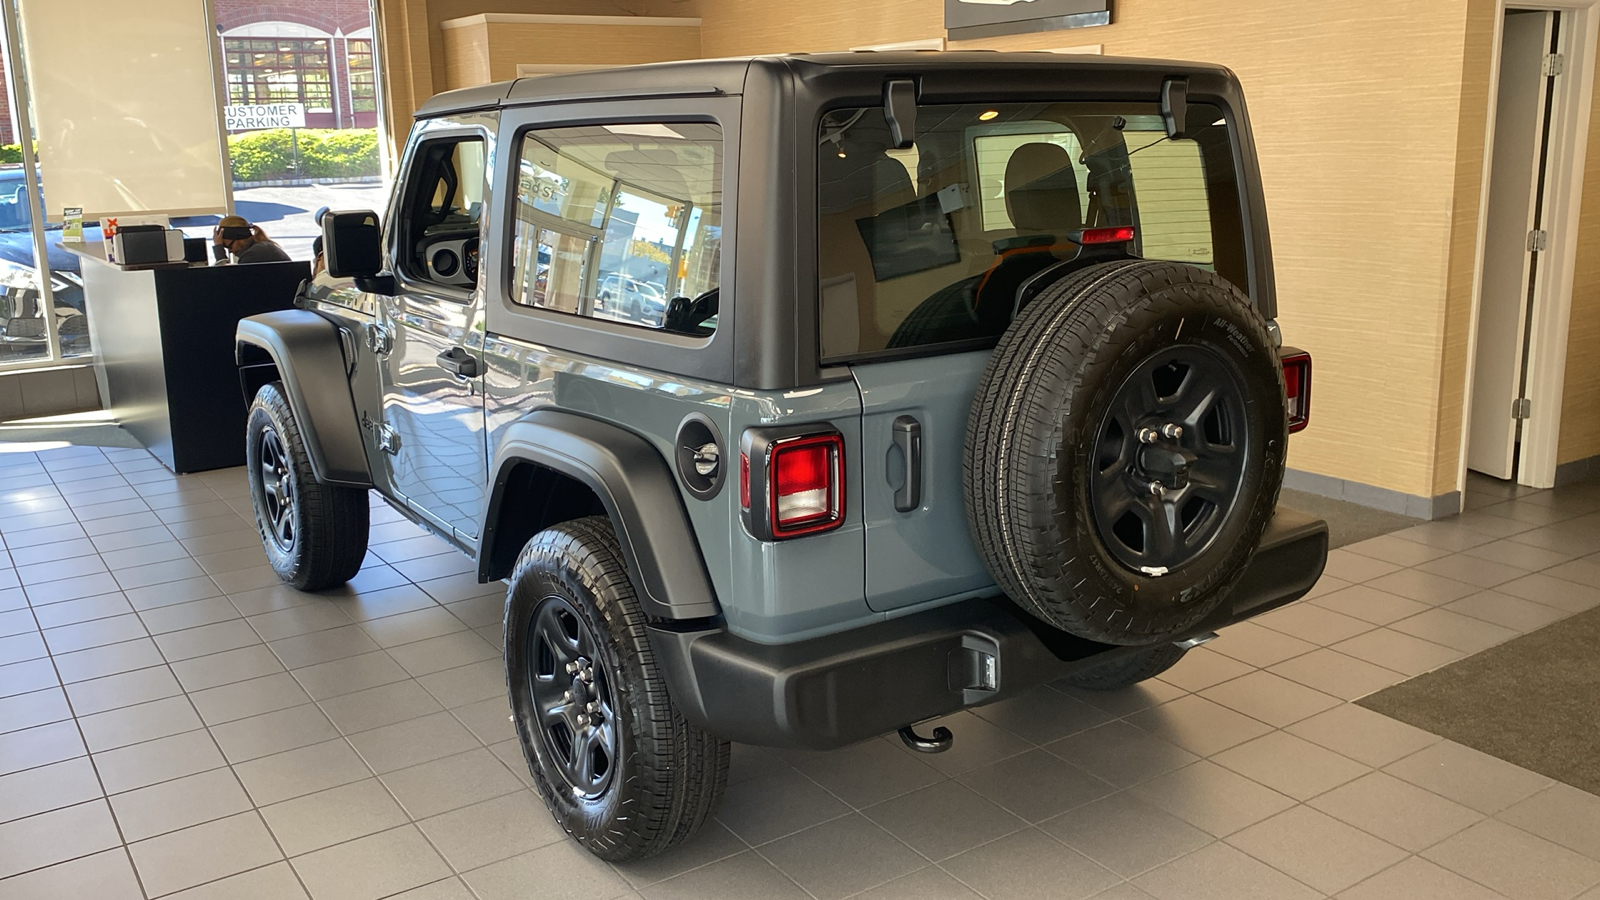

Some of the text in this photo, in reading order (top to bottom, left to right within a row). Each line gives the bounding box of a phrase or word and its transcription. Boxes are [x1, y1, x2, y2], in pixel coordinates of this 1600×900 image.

[224, 105, 297, 119] USTOMER
[227, 116, 290, 129] PARKING
[541, 186, 558, 201] St.
[1213, 317, 1255, 353] All-Weather
